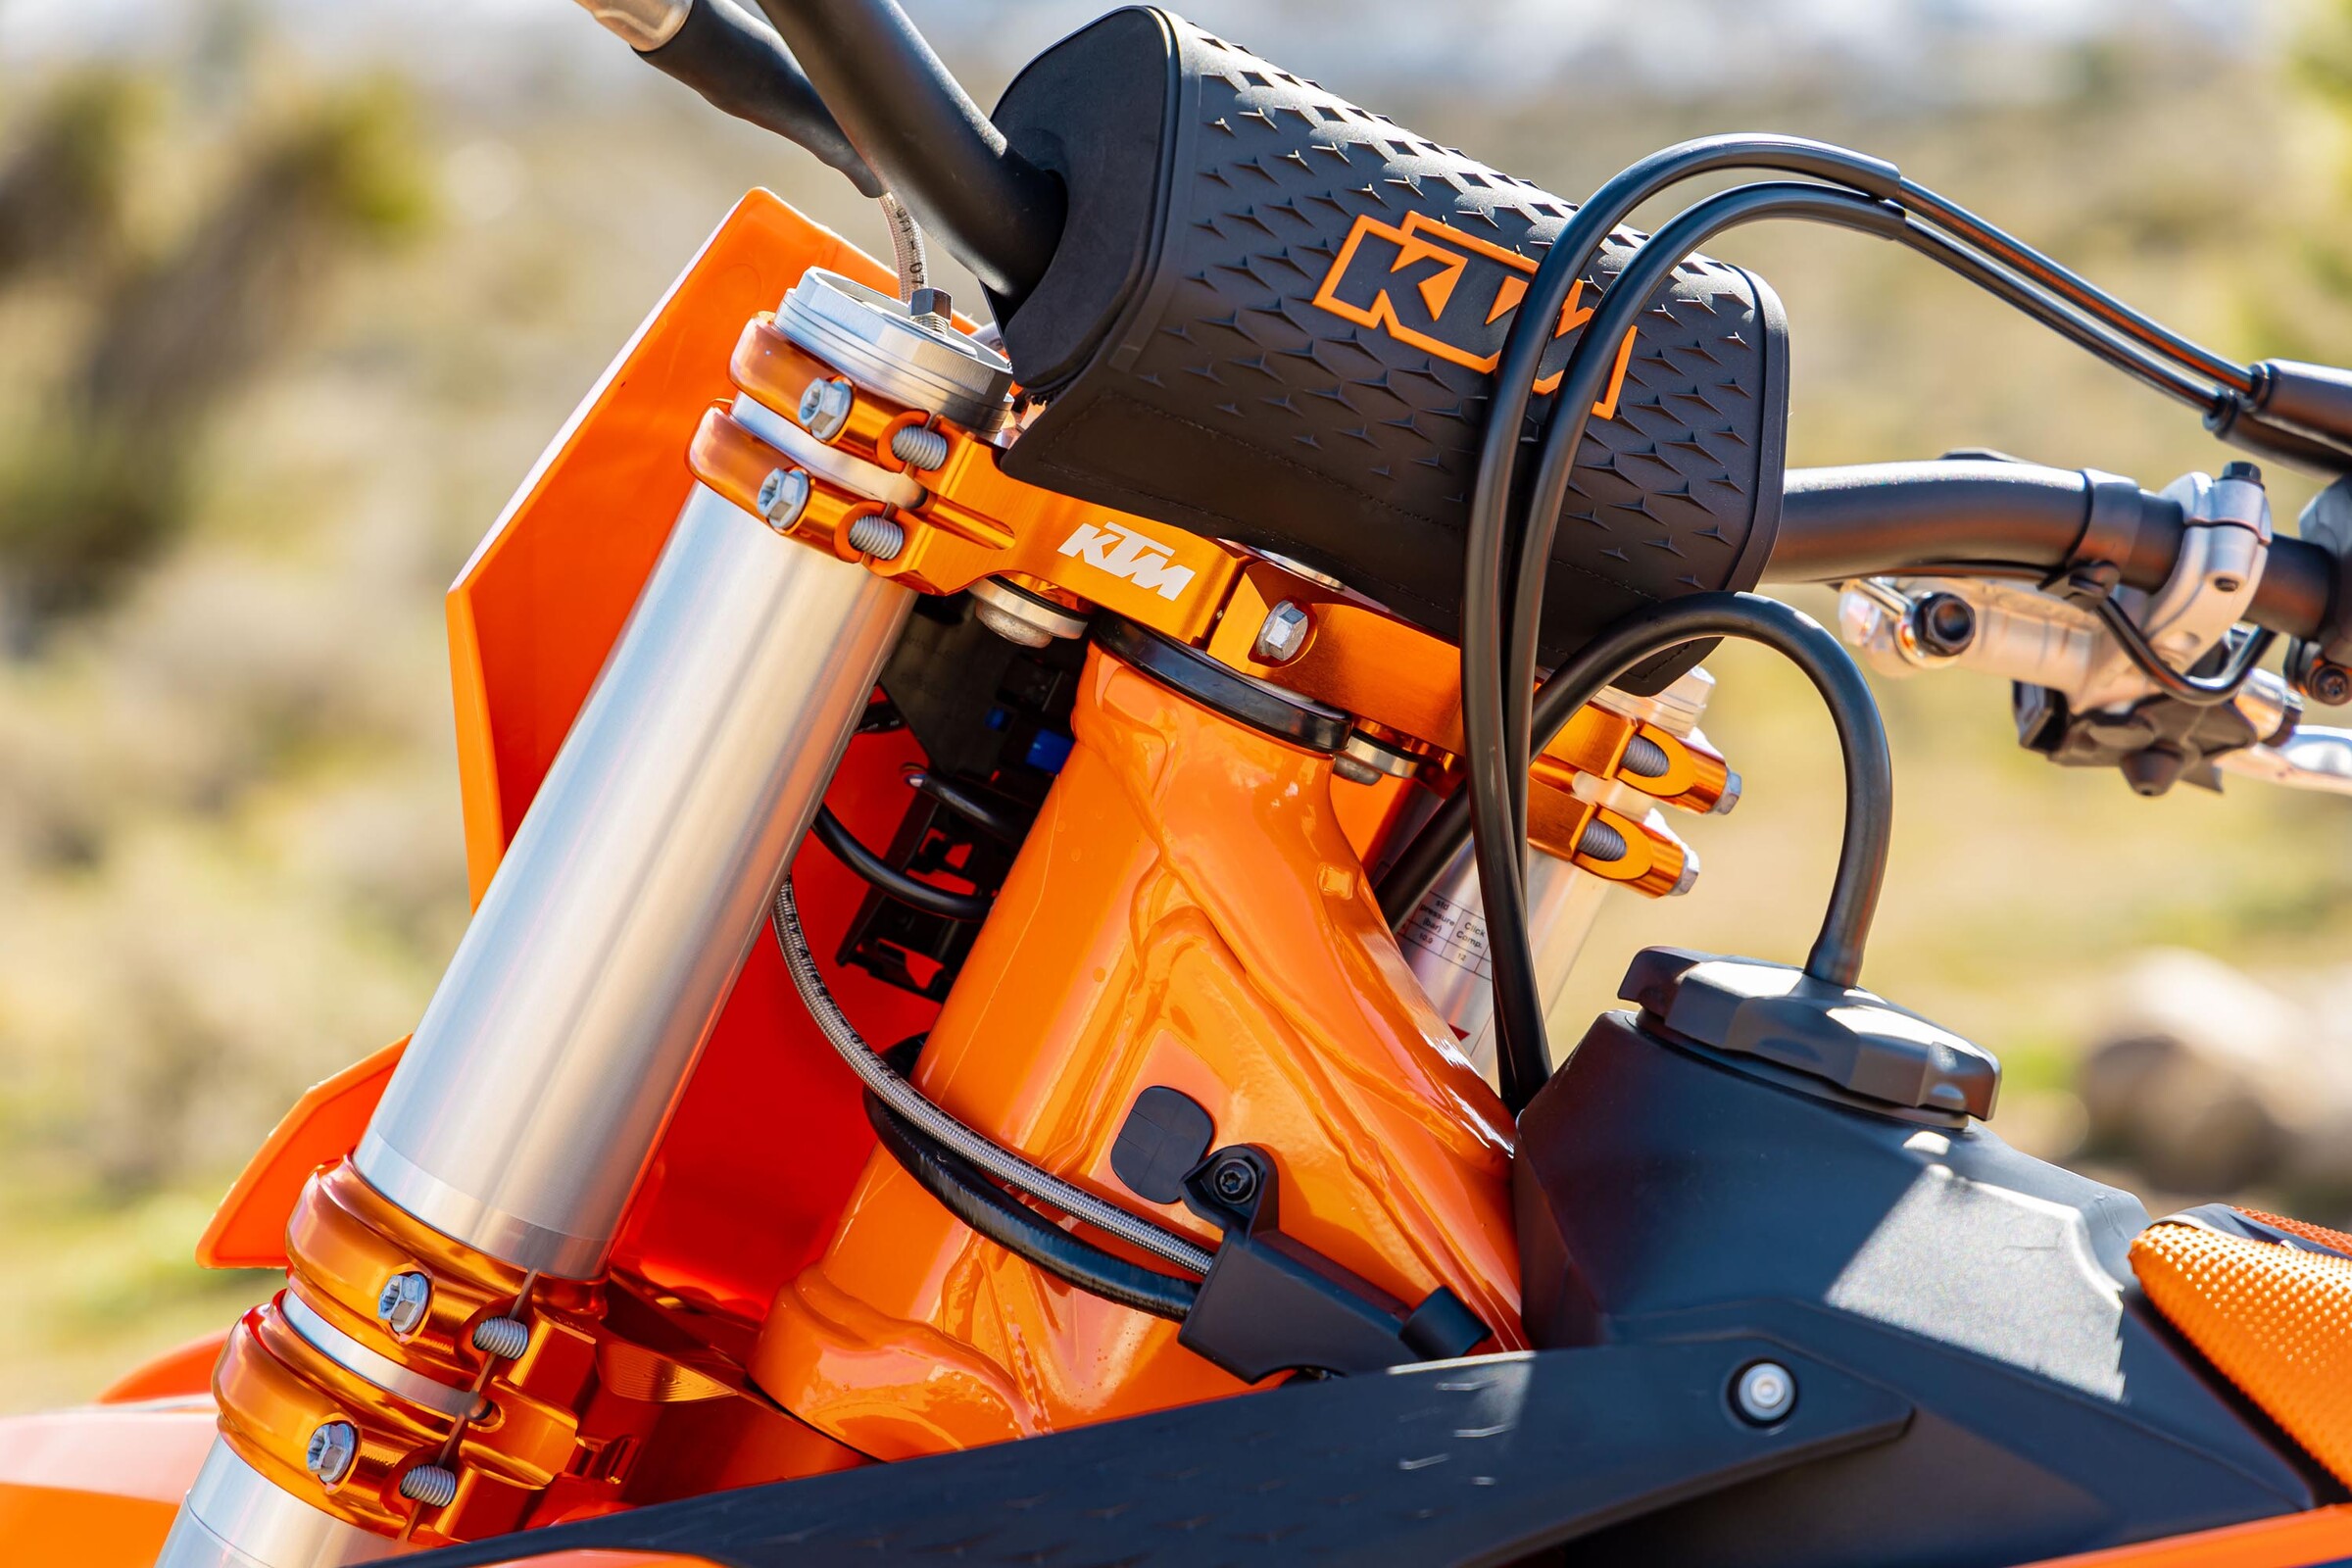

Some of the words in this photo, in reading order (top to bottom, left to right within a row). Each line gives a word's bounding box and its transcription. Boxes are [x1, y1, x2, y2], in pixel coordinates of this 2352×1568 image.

[1056, 520, 1197, 602] KTM
[1419, 904, 1455, 927] pressure
[1422, 917, 1443, 933] (bar)
[1455, 930, 1483, 949] Comp.
[1464, 922, 1486, 938] Click
